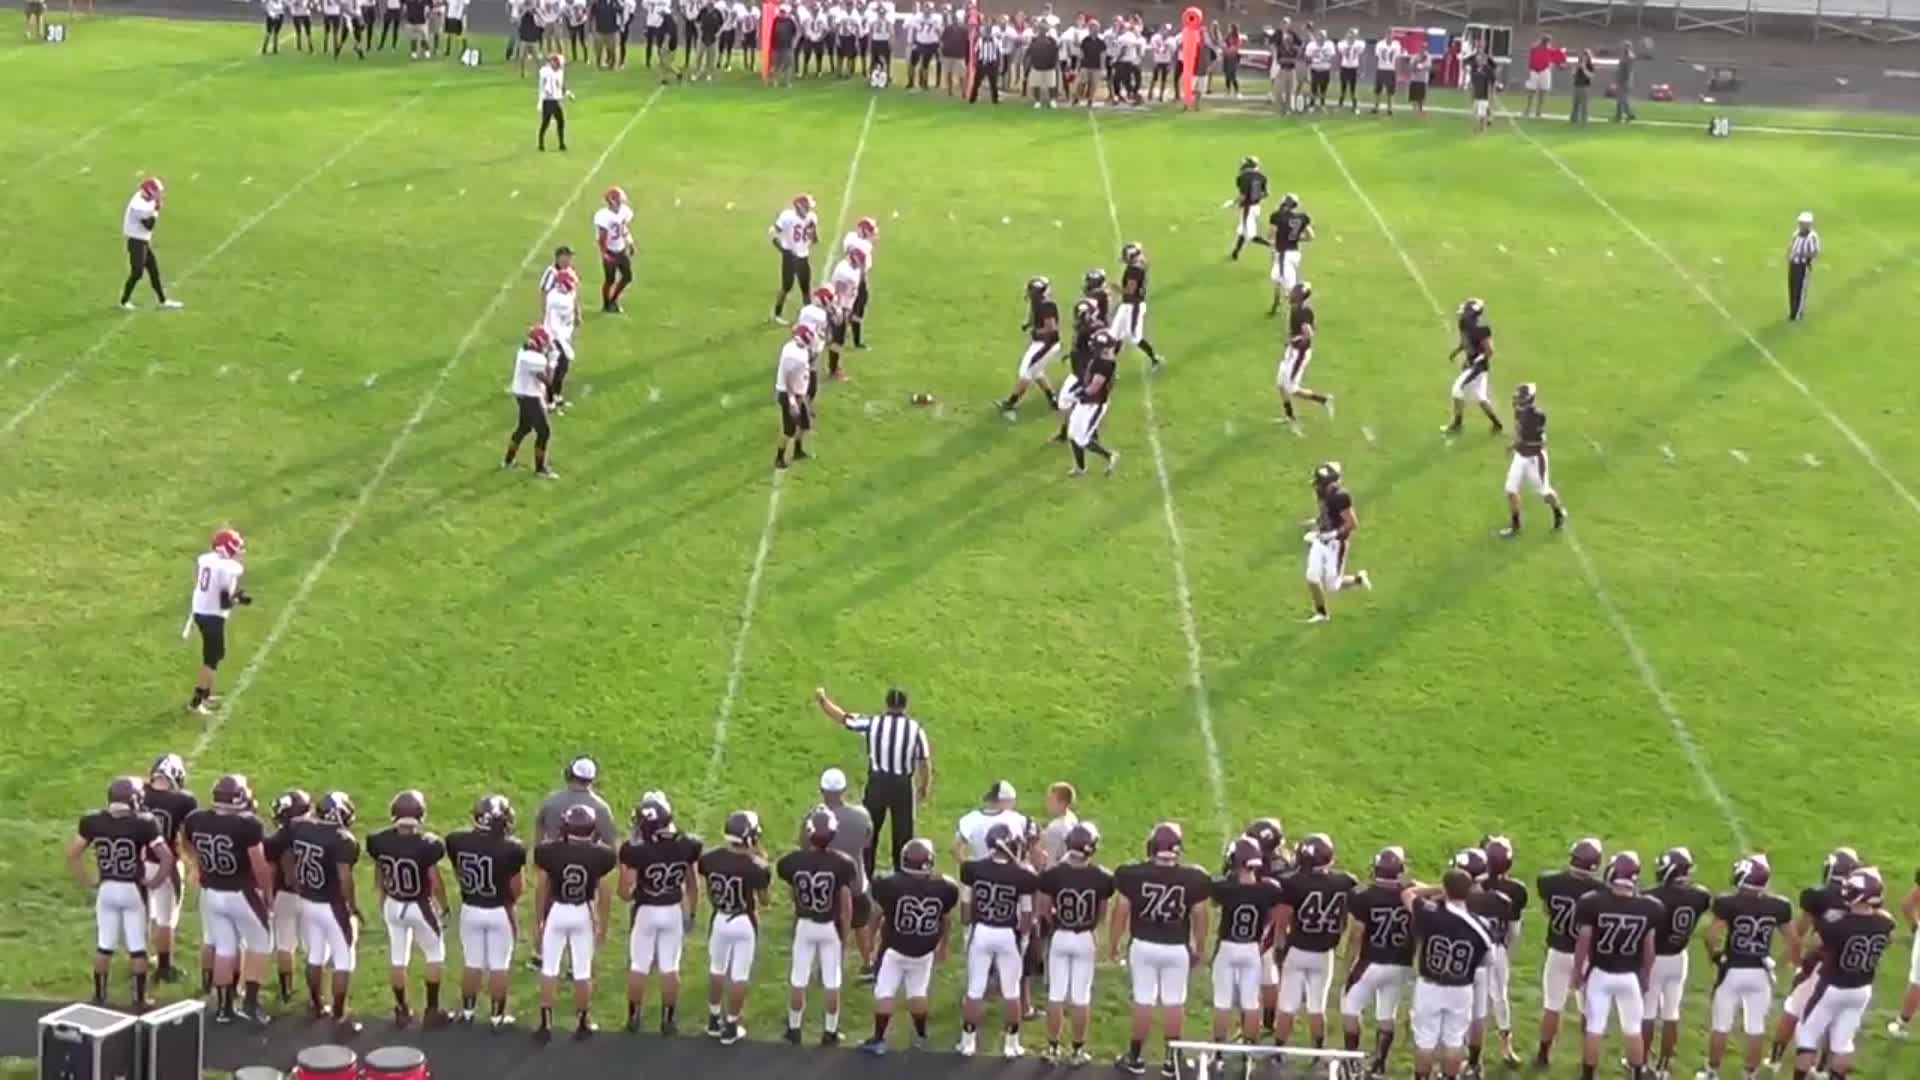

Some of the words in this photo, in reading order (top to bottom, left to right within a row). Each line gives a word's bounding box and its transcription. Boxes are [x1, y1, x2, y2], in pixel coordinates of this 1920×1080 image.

[47, 24, 63, 41] 30
[92, 837, 138, 879] 22
[193, 834, 237, 875] 56
[293, 840, 325, 889] 75
[457, 852, 497, 895] 51
[561, 863, 588, 903] 2
[794, 871, 836, 912] 83
[1140, 882, 1186, 921] 74
[894, 896, 942, 935] 62
[1056, 888, 1096, 927] 81
[1231, 904, 1259, 941] 8
[1298, 891, 1347, 933] 44
[1370, 906, 1413, 948] 73
[1670, 906, 1696, 942] 9
[1597, 912, 1648, 955] 77
[1427, 935, 1475, 977] 68
